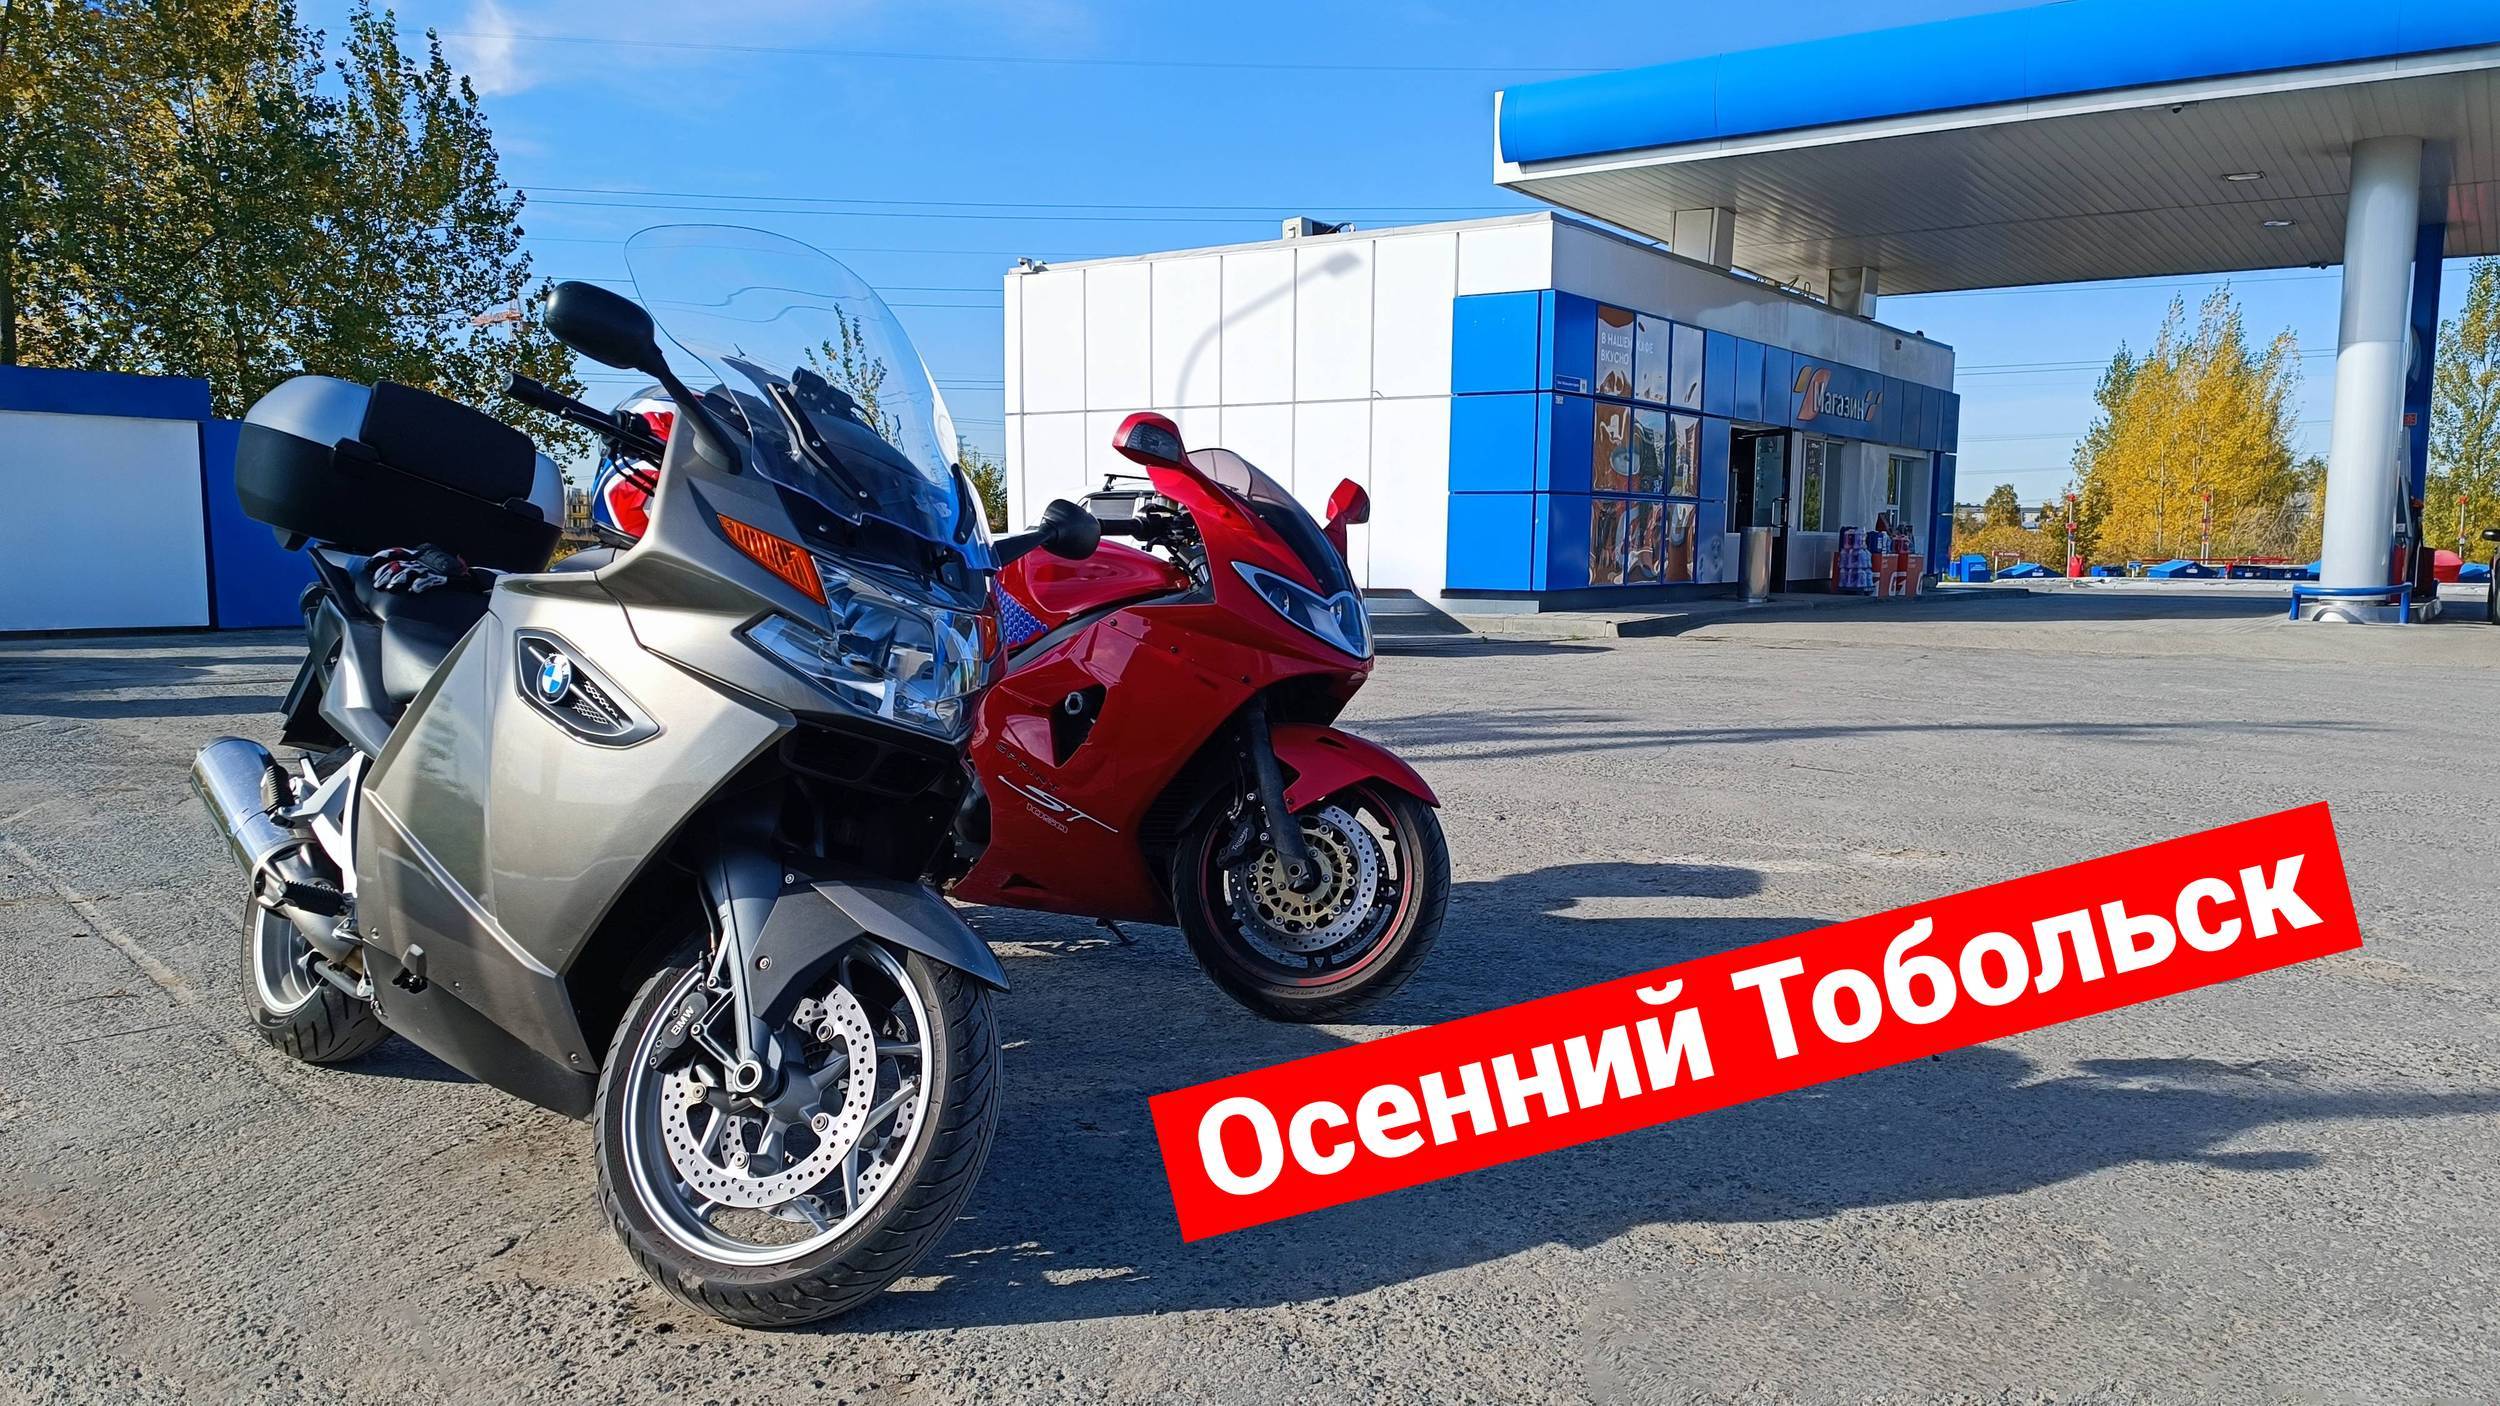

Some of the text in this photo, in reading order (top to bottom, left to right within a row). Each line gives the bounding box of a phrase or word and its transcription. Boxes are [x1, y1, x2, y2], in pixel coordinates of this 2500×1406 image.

[1601, 331, 1607, 345] В
[1600, 349, 1630, 366] ВКУСНО
[1813, 380, 1865, 421] Магазин
[670, 1005, 695, 1036] BMW
